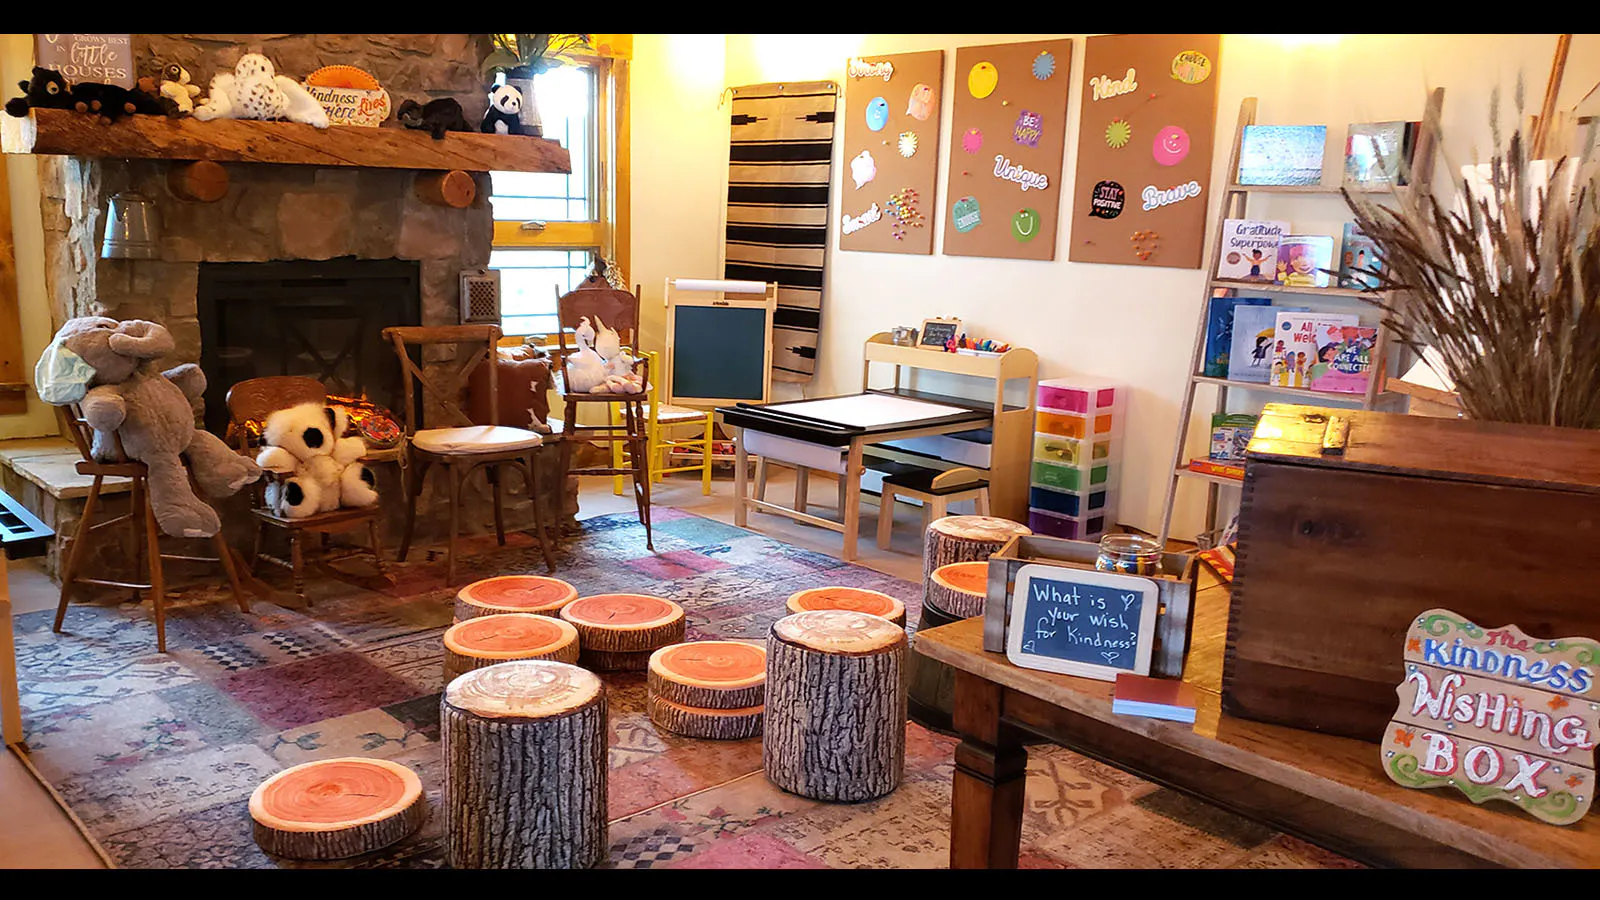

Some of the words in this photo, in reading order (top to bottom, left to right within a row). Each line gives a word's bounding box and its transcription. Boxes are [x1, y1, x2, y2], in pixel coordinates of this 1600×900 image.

[71, 42, 117, 67] little
[1090, 69, 1137, 101] Kind
[1023, 115, 1036, 127] BE
[1015, 126, 1040, 142] HAPPY
[994, 155, 1048, 191] Unique
[1100, 186, 1120, 200] STAY
[1143, 182, 1201, 211] Brave
[1093, 198, 1121, 210] POSITIVE
[1236, 224, 1282, 236] Gratitude
[1301, 322, 1313, 332] All
[1334, 353, 1350, 363] ARE
[1352, 354, 1369, 364] ALL
[1346, 345, 1357, 354] WE
[1033, 584, 1081, 606] What
[1090, 594, 1106, 609] is
[1048, 607, 1079, 626] your
[1035, 617, 1057, 639] for
[1486, 630, 1531, 651] The
[1418, 732, 1551, 798] BOX
